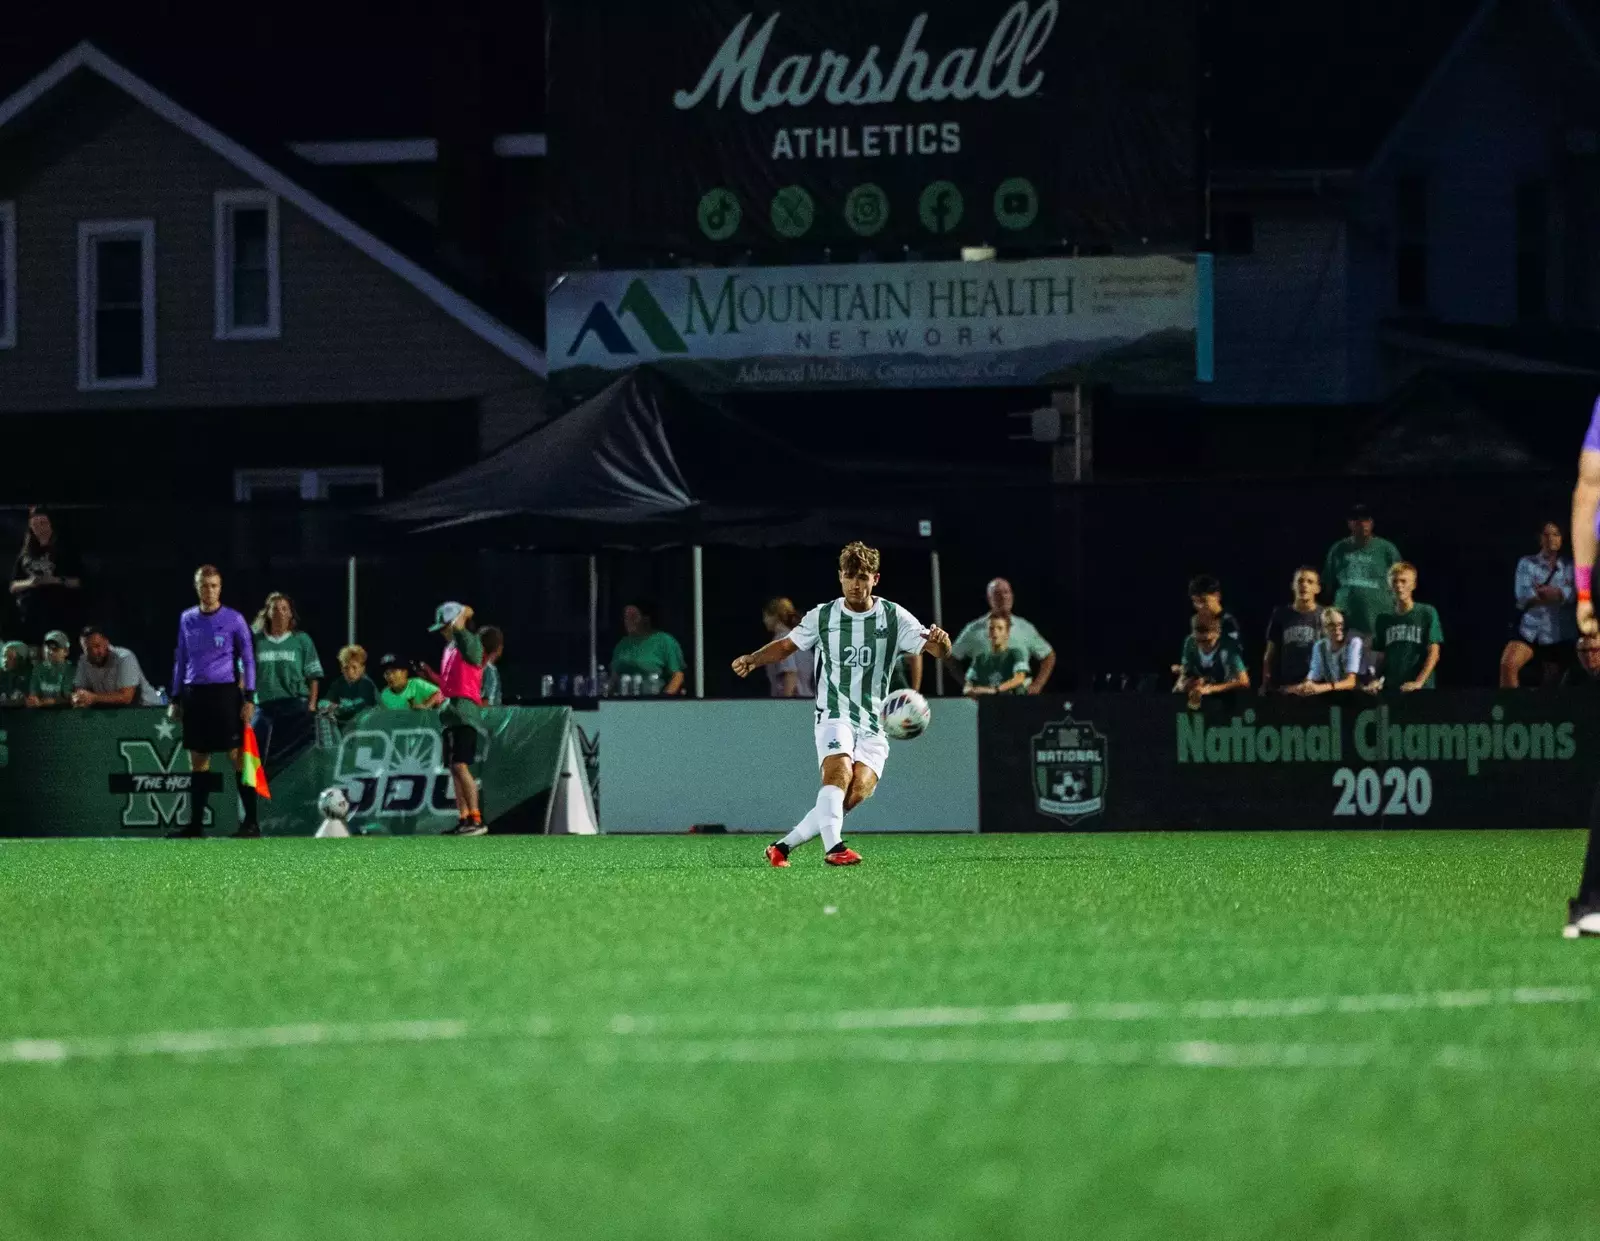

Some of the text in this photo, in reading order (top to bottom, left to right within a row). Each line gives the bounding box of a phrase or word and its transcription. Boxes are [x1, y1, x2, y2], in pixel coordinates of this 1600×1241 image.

[673, 0, 1059, 115] Marshall
[771, 121, 961, 160] ATHLETICS
[684, 274, 913, 335] MOUNTAIN
[927, 276, 1076, 319] HEALTH
[795, 327, 1004, 350] NETWORK
[843, 645, 872, 667] 20
[1036, 749, 1103, 763] NATIONAL
[1176, 704, 1577, 776] National Champions
[131, 775, 164, 792] THE
[1332, 766, 1433, 816] 2020
